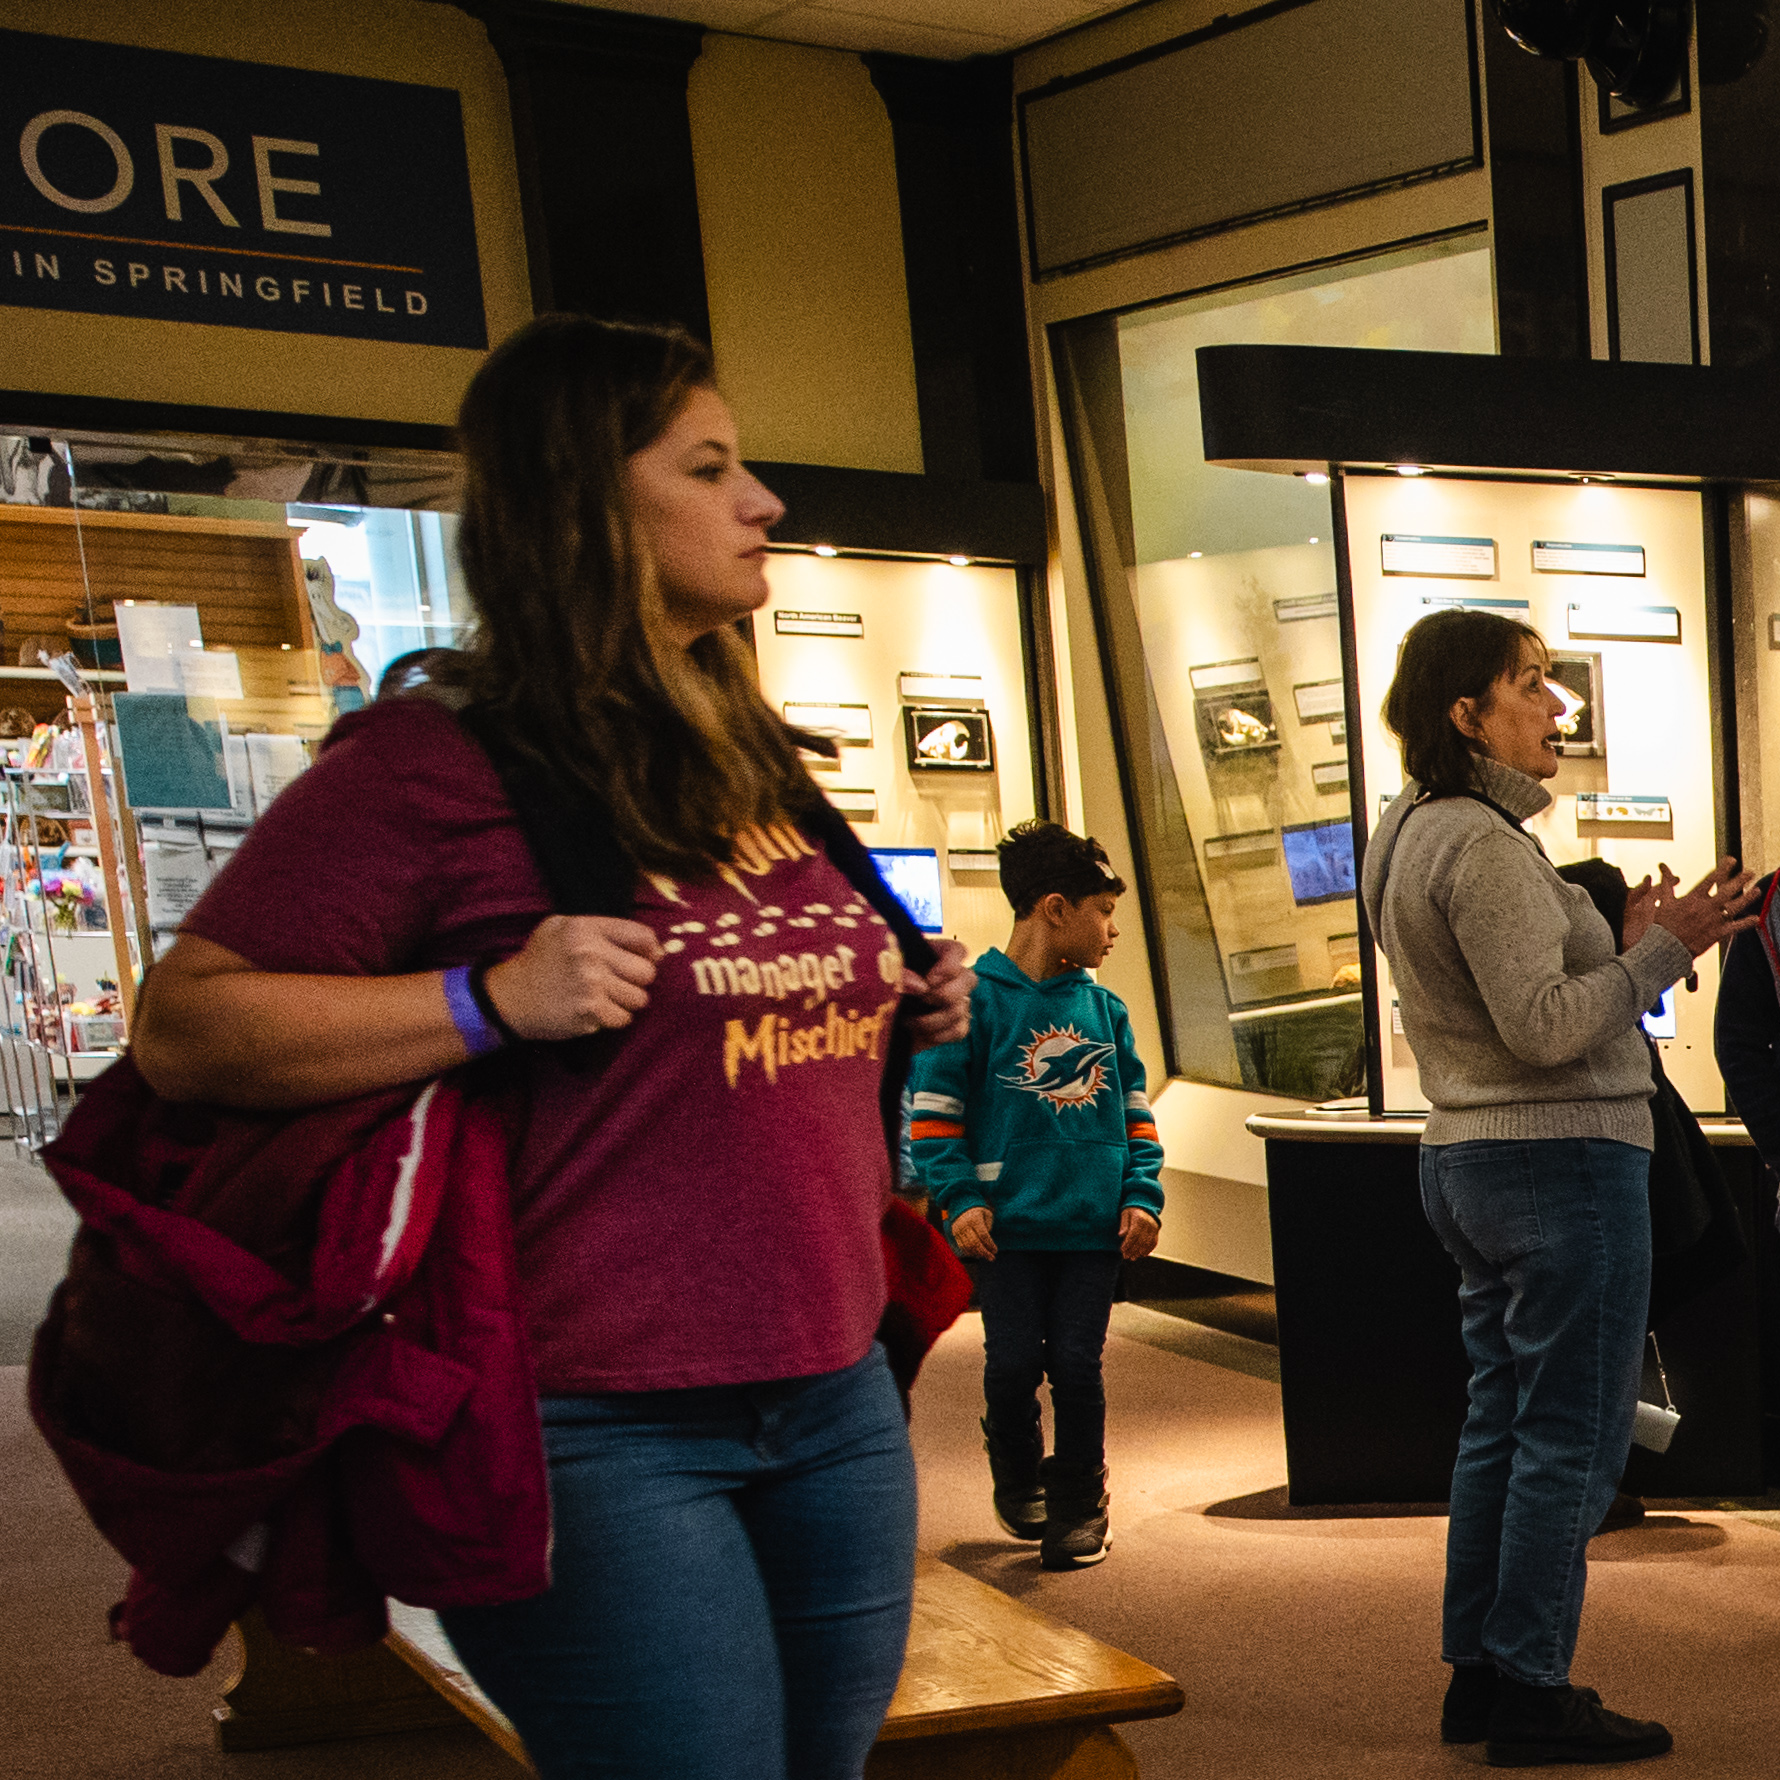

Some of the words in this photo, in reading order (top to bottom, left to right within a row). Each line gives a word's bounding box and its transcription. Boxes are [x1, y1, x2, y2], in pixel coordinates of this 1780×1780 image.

[13, 252, 61, 281] IN
[94, 258, 429, 317] SPRINGFIELD
[691, 944, 858, 1009] manager
[723, 1000, 896, 1089] Mischief
